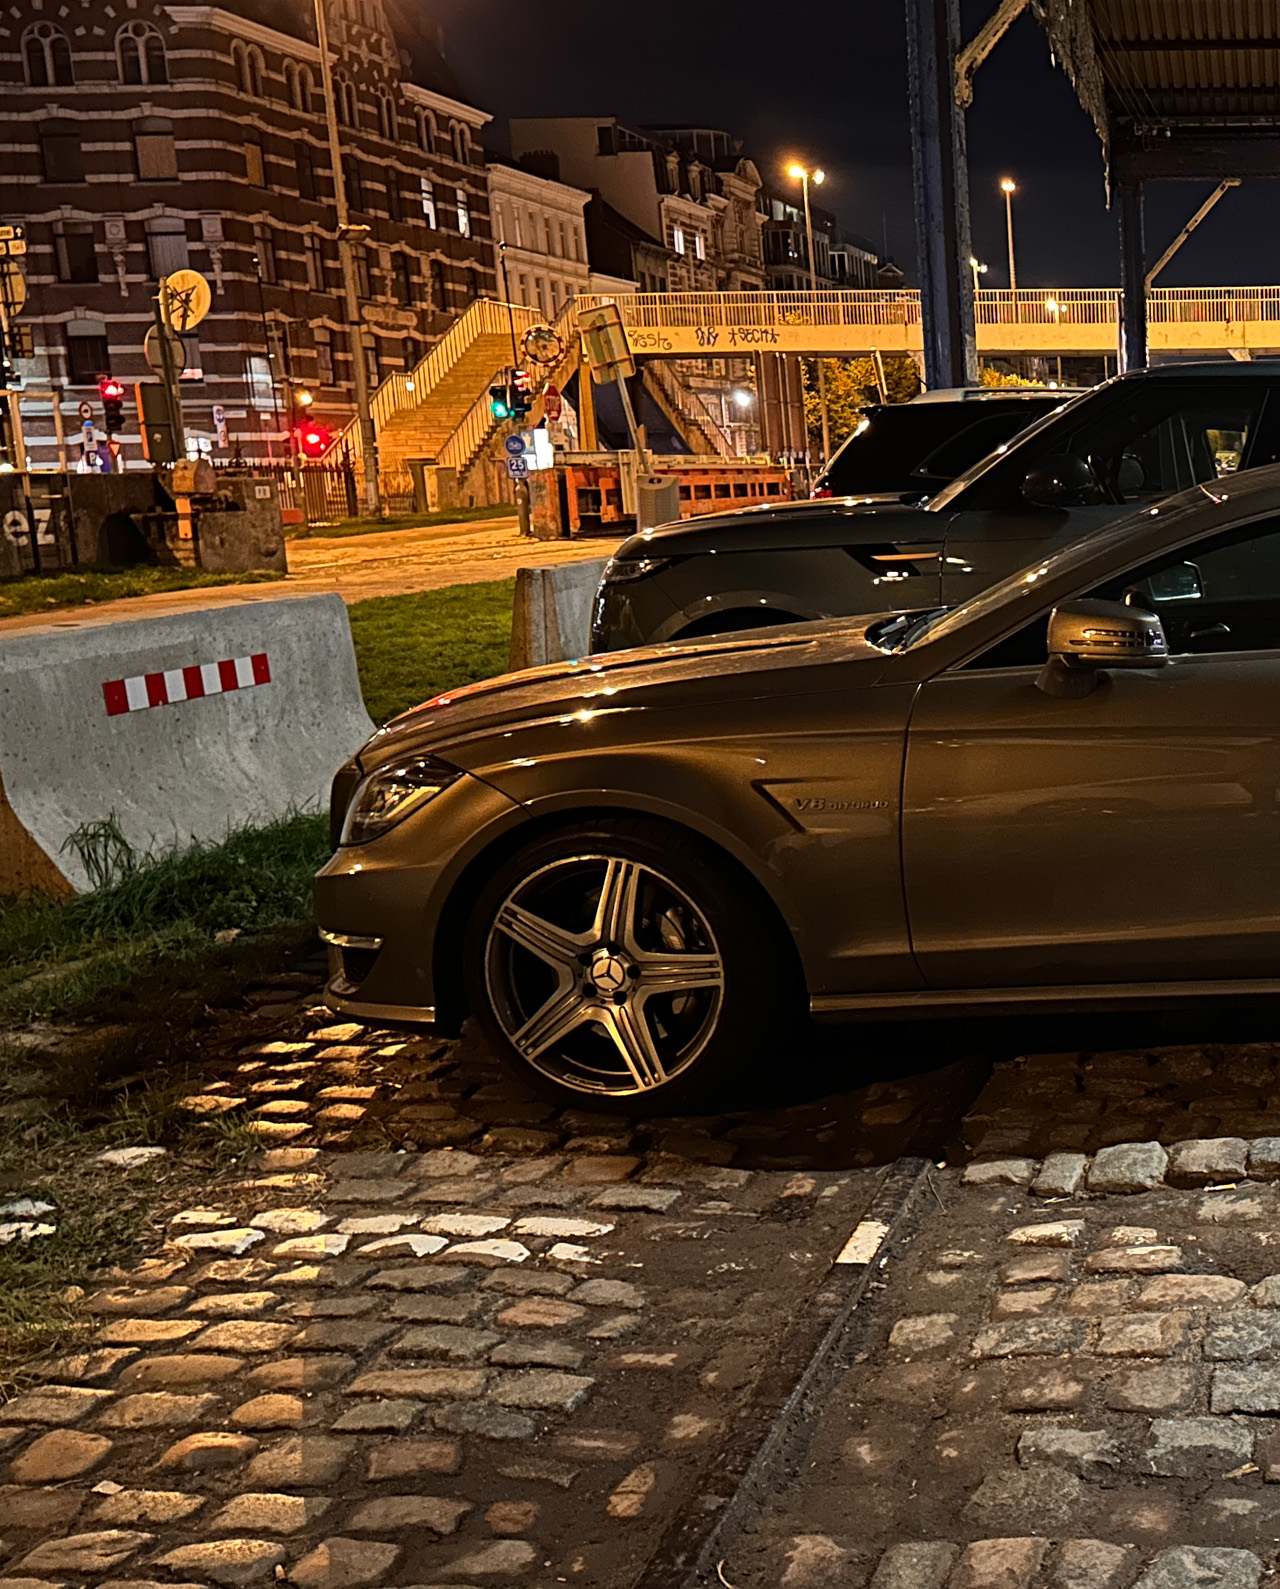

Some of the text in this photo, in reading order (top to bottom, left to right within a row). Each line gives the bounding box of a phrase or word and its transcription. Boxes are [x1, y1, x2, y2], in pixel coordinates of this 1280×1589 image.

[511, 460, 524, 470] 25
[795, 798, 889, 811] V8 BITURBO
